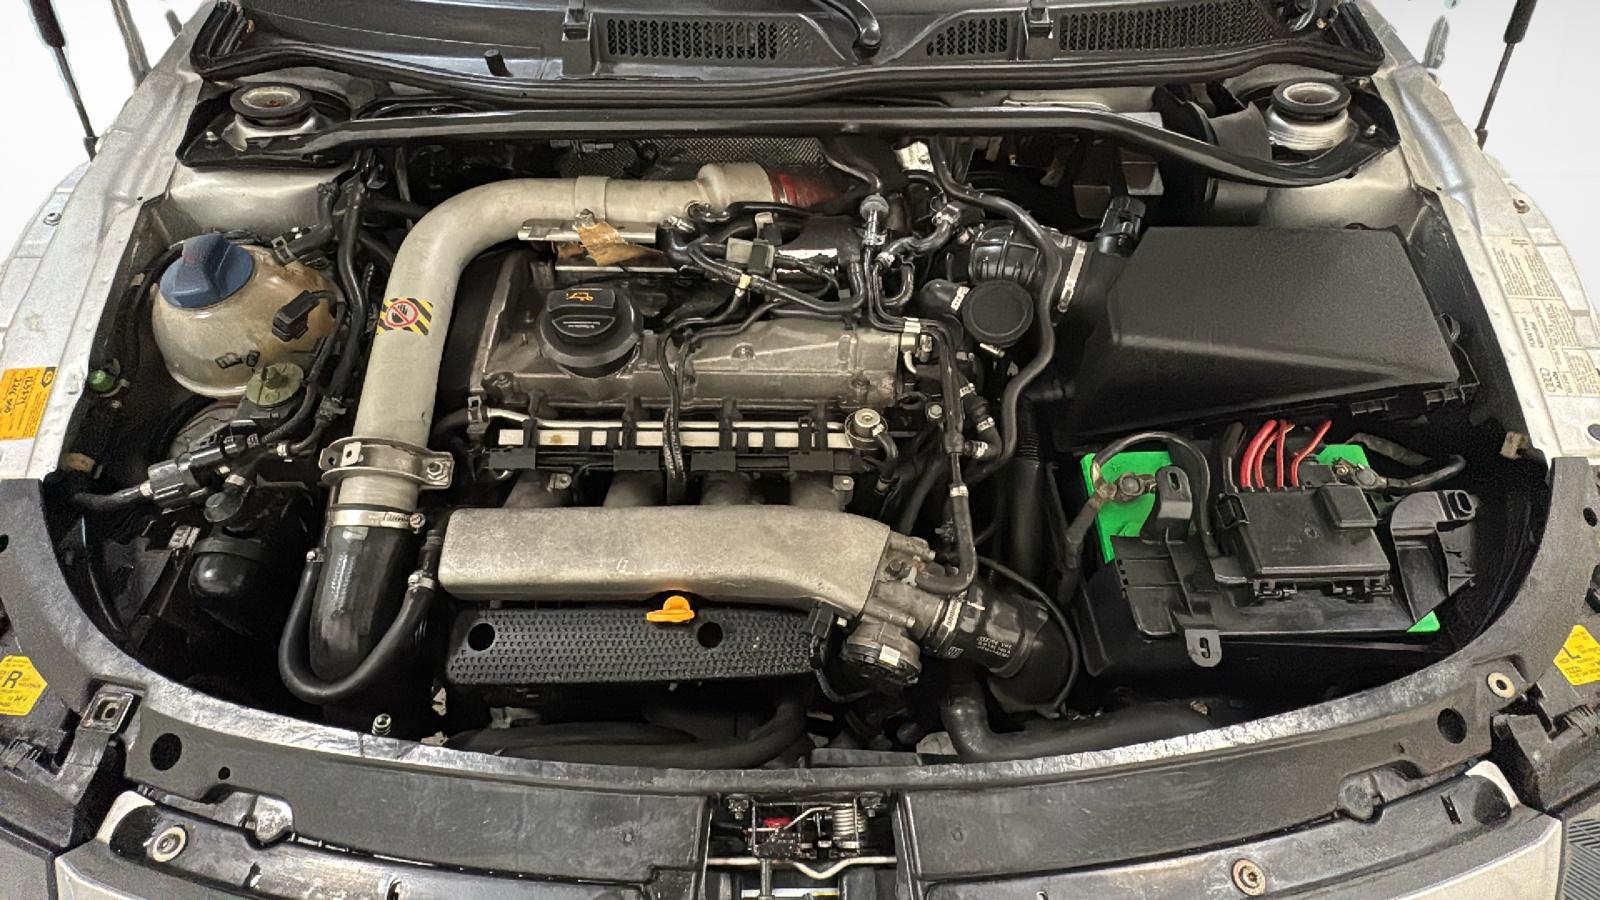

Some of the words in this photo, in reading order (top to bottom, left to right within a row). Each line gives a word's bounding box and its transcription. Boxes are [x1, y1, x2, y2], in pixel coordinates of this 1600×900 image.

[1552, 371, 1563, 390] Audi
[1562, 646, 1582, 660] L
[2, 670, 23, 688] R
